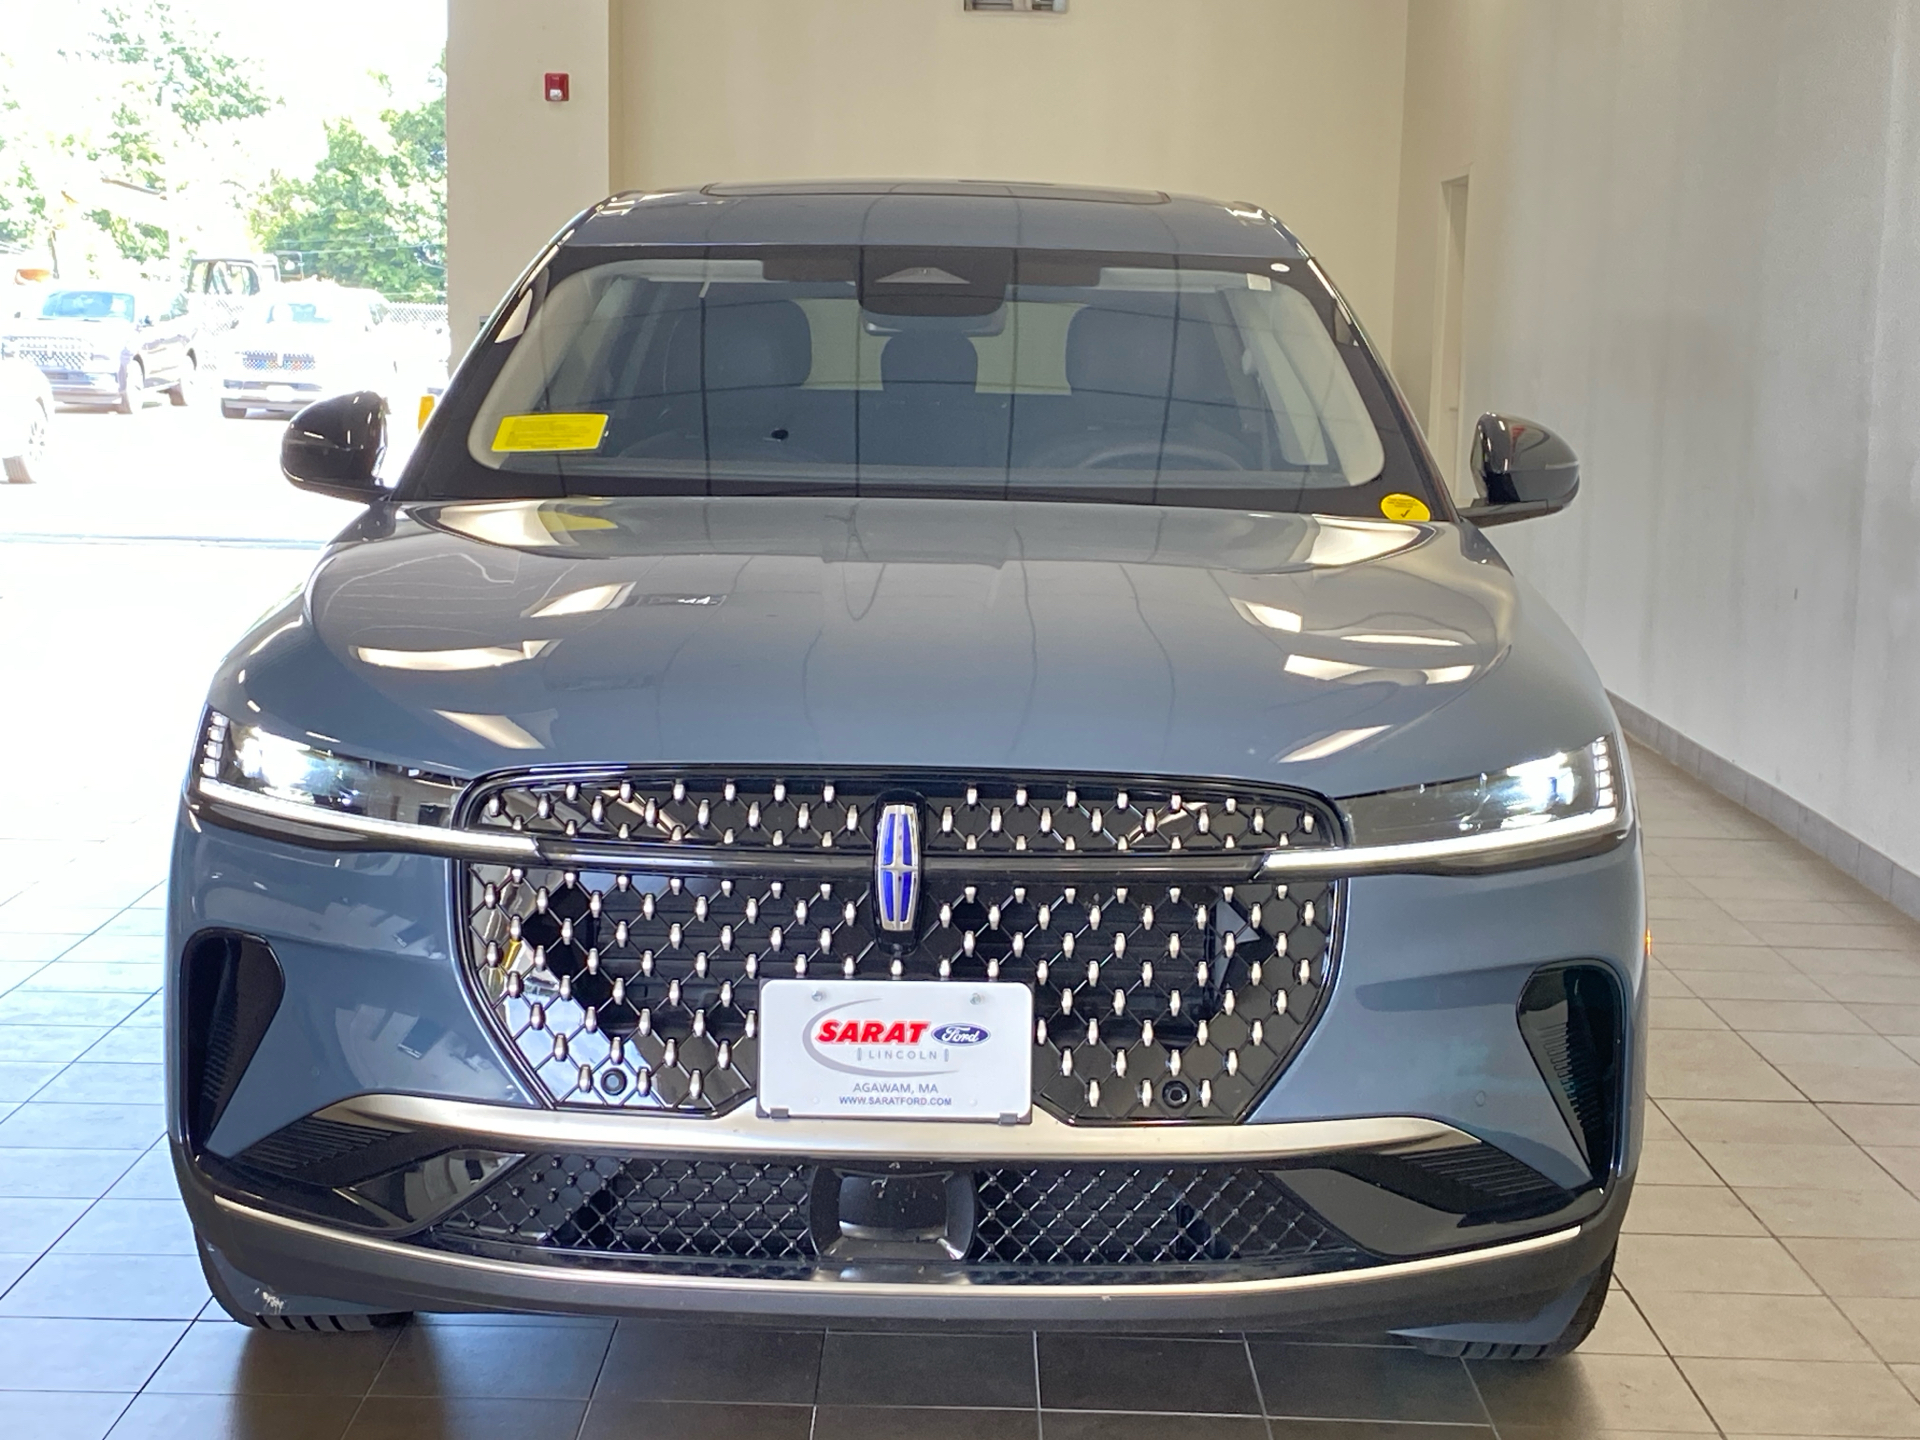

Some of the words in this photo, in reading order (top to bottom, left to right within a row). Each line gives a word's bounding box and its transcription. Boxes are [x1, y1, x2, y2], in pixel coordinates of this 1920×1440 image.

[815, 1020, 931, 1045] SARAT
[941, 1027, 980, 1043] Ford
[868, 1050, 938, 1060] LINCOLN
[853, 1083, 915, 1094] AGAWAM,
[918, 1084, 939, 1094] MA
[839, 1097, 952, 1106] WWW.SARATFORD.COM
